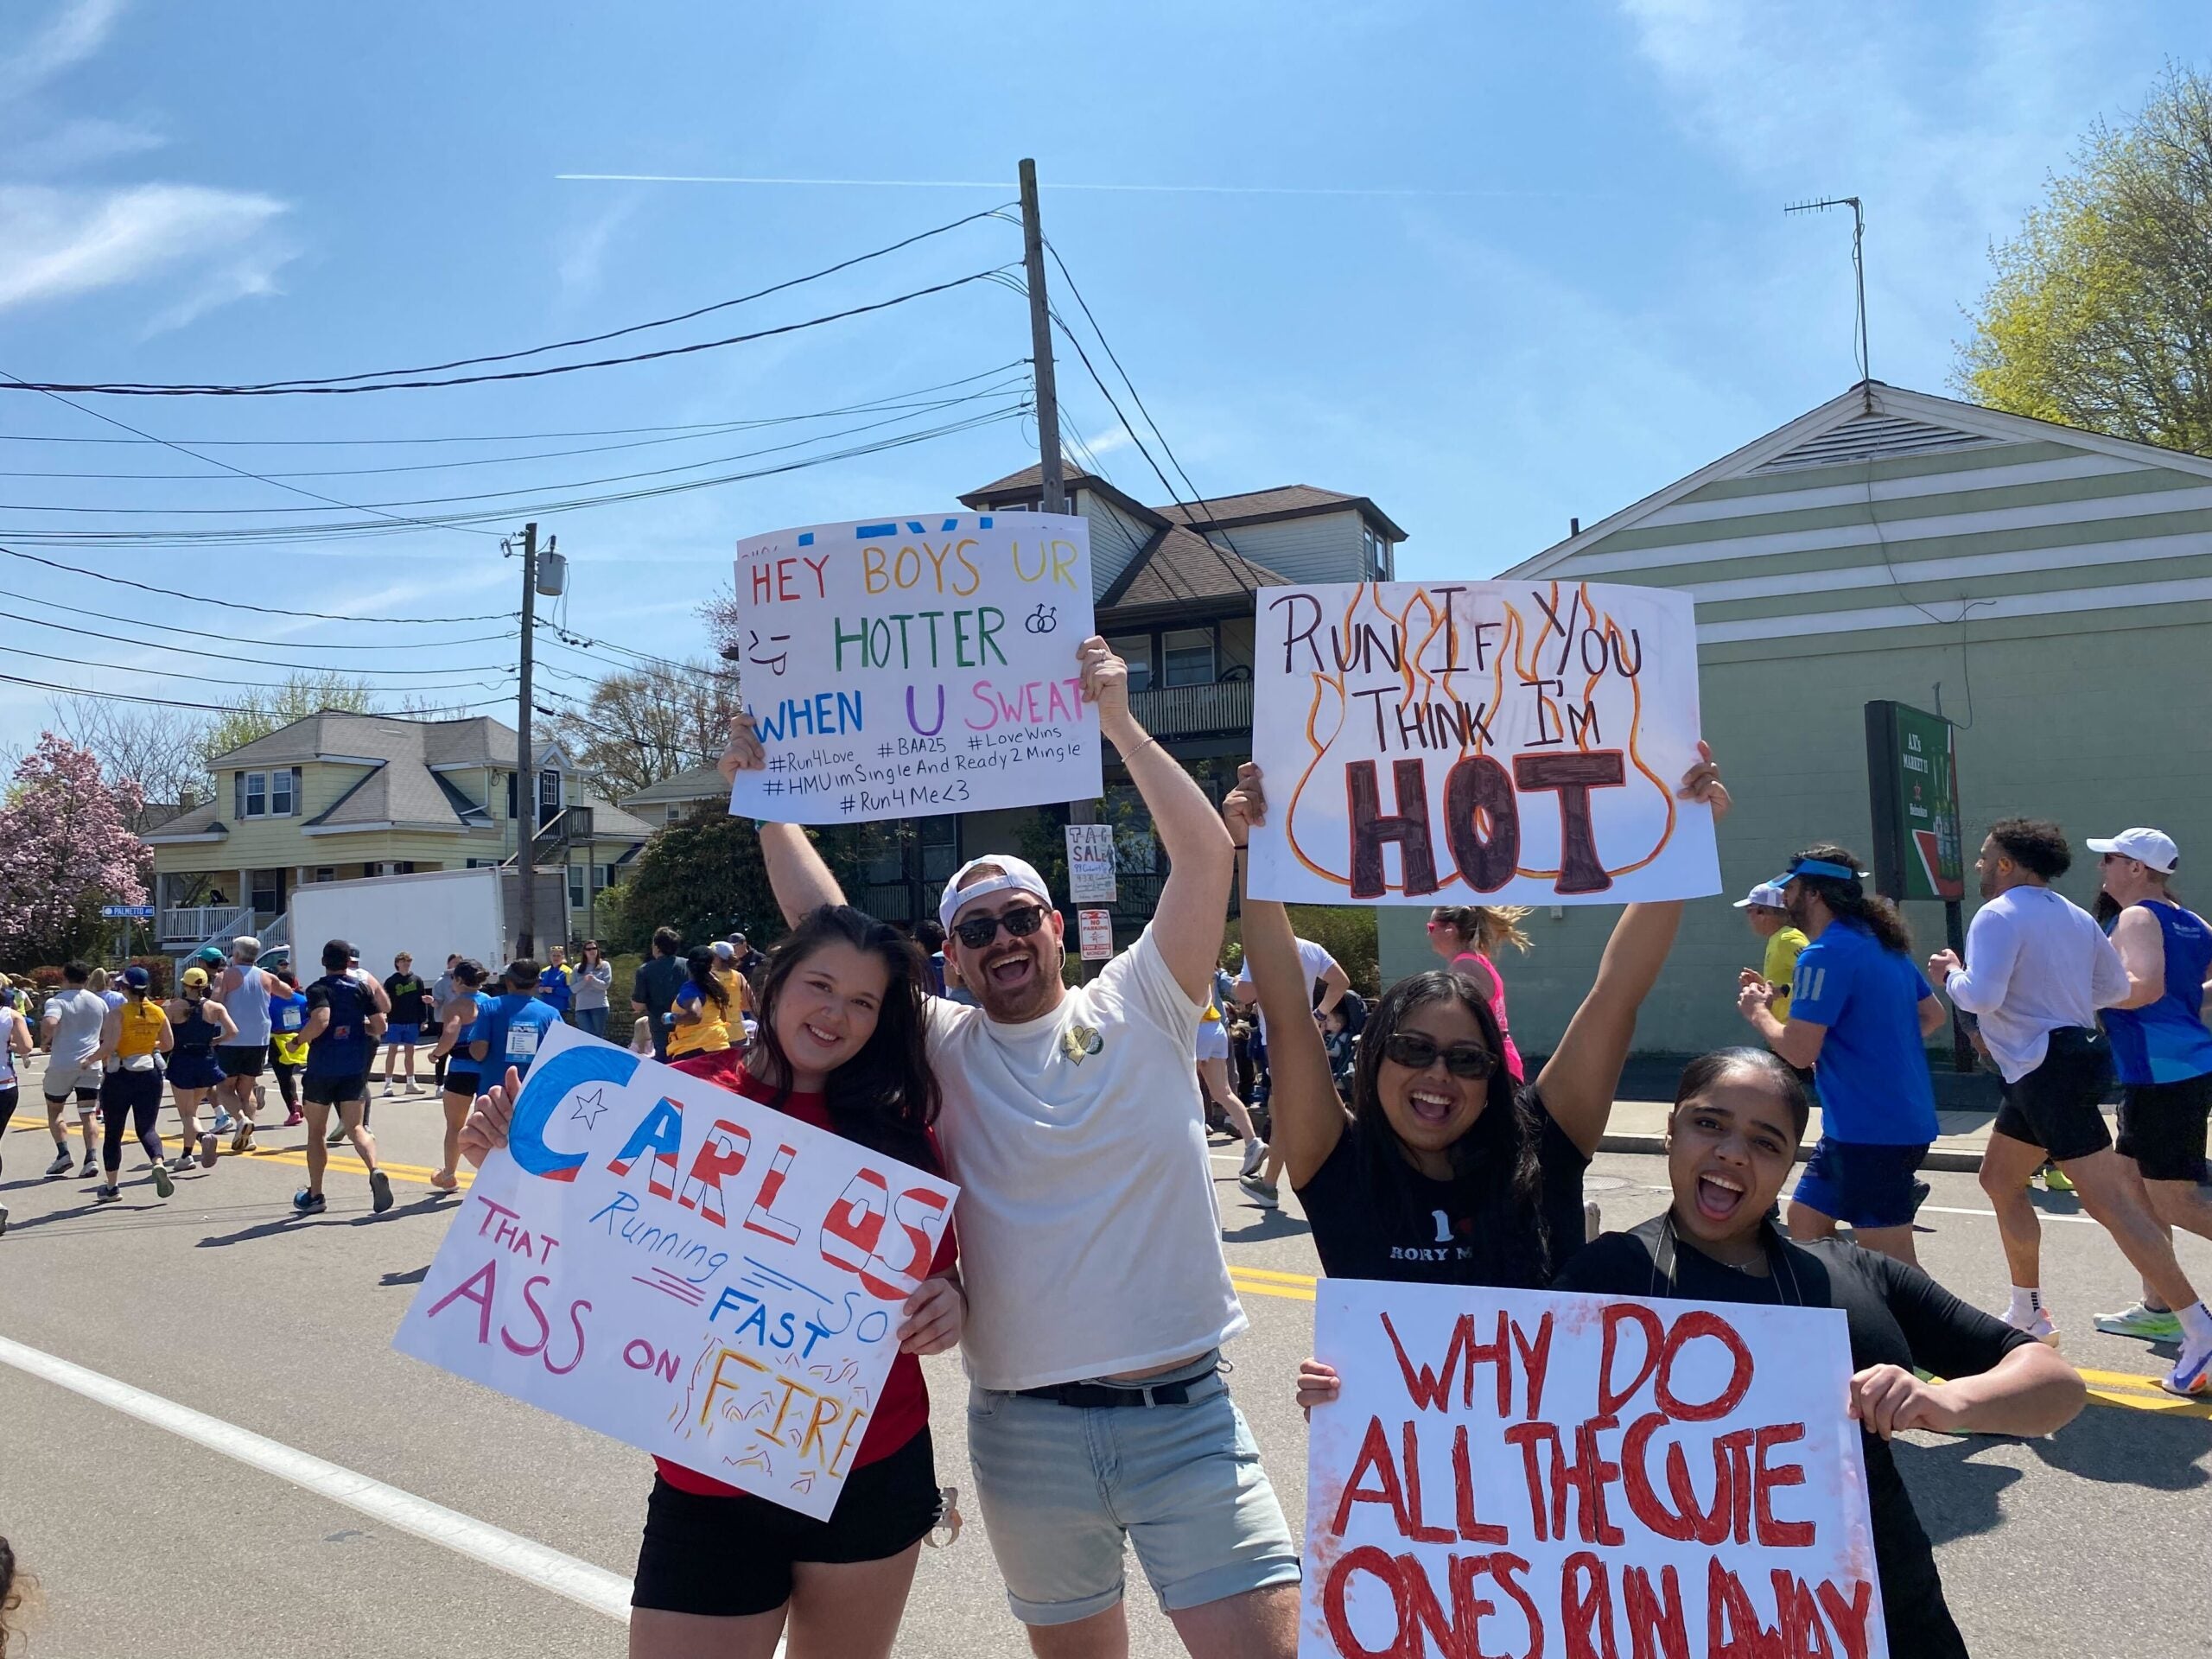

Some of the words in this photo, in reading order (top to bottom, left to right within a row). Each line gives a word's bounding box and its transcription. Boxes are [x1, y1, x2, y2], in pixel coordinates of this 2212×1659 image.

[752, 555, 830, 605] HEY
[863, 539, 980, 596] BOYS
[1011, 540, 1078, 591] UR
[834, 607, 1008, 672] HOTTER
[1269, 594, 1401, 674] RUN
[1429, 587, 1502, 672] IF
[1532, 589, 1642, 677] YOU
[748, 690, 863, 743] WHEN
[906, 684, 945, 736] U
[963, 677, 1084, 731] SWEAT
[768, 749, 855, 772] #Run4Love
[877, 737, 947, 759] #BAA25
[967, 726, 1063, 751] #LoveWins
[1351, 687, 1494, 752] THINK
[1519, 679, 1600, 747] I'M
[1345, 749, 1626, 899] HOT
[509, 1046, 949, 1301] CARLOS
[477, 1195, 560, 1265] THAT
[589, 1190, 729, 1281] Running
[1389, 1247, 1448, 1261] RORY
[708, 1287, 830, 1360] FAST
[1380, 1309, 1554, 1421] WHY
[1598, 1303, 1754, 1422] DO
[427, 1259, 592, 1375] ASS
[623, 1338, 681, 1382] ON
[699, 1349, 868, 1480] FIRE
[1332, 1414, 1509, 1546] ALL
[1504, 1415, 1625, 1546] THE
[1621, 1412, 1815, 1548] CUTE
[1323, 1545, 1544, 1659] ONES
